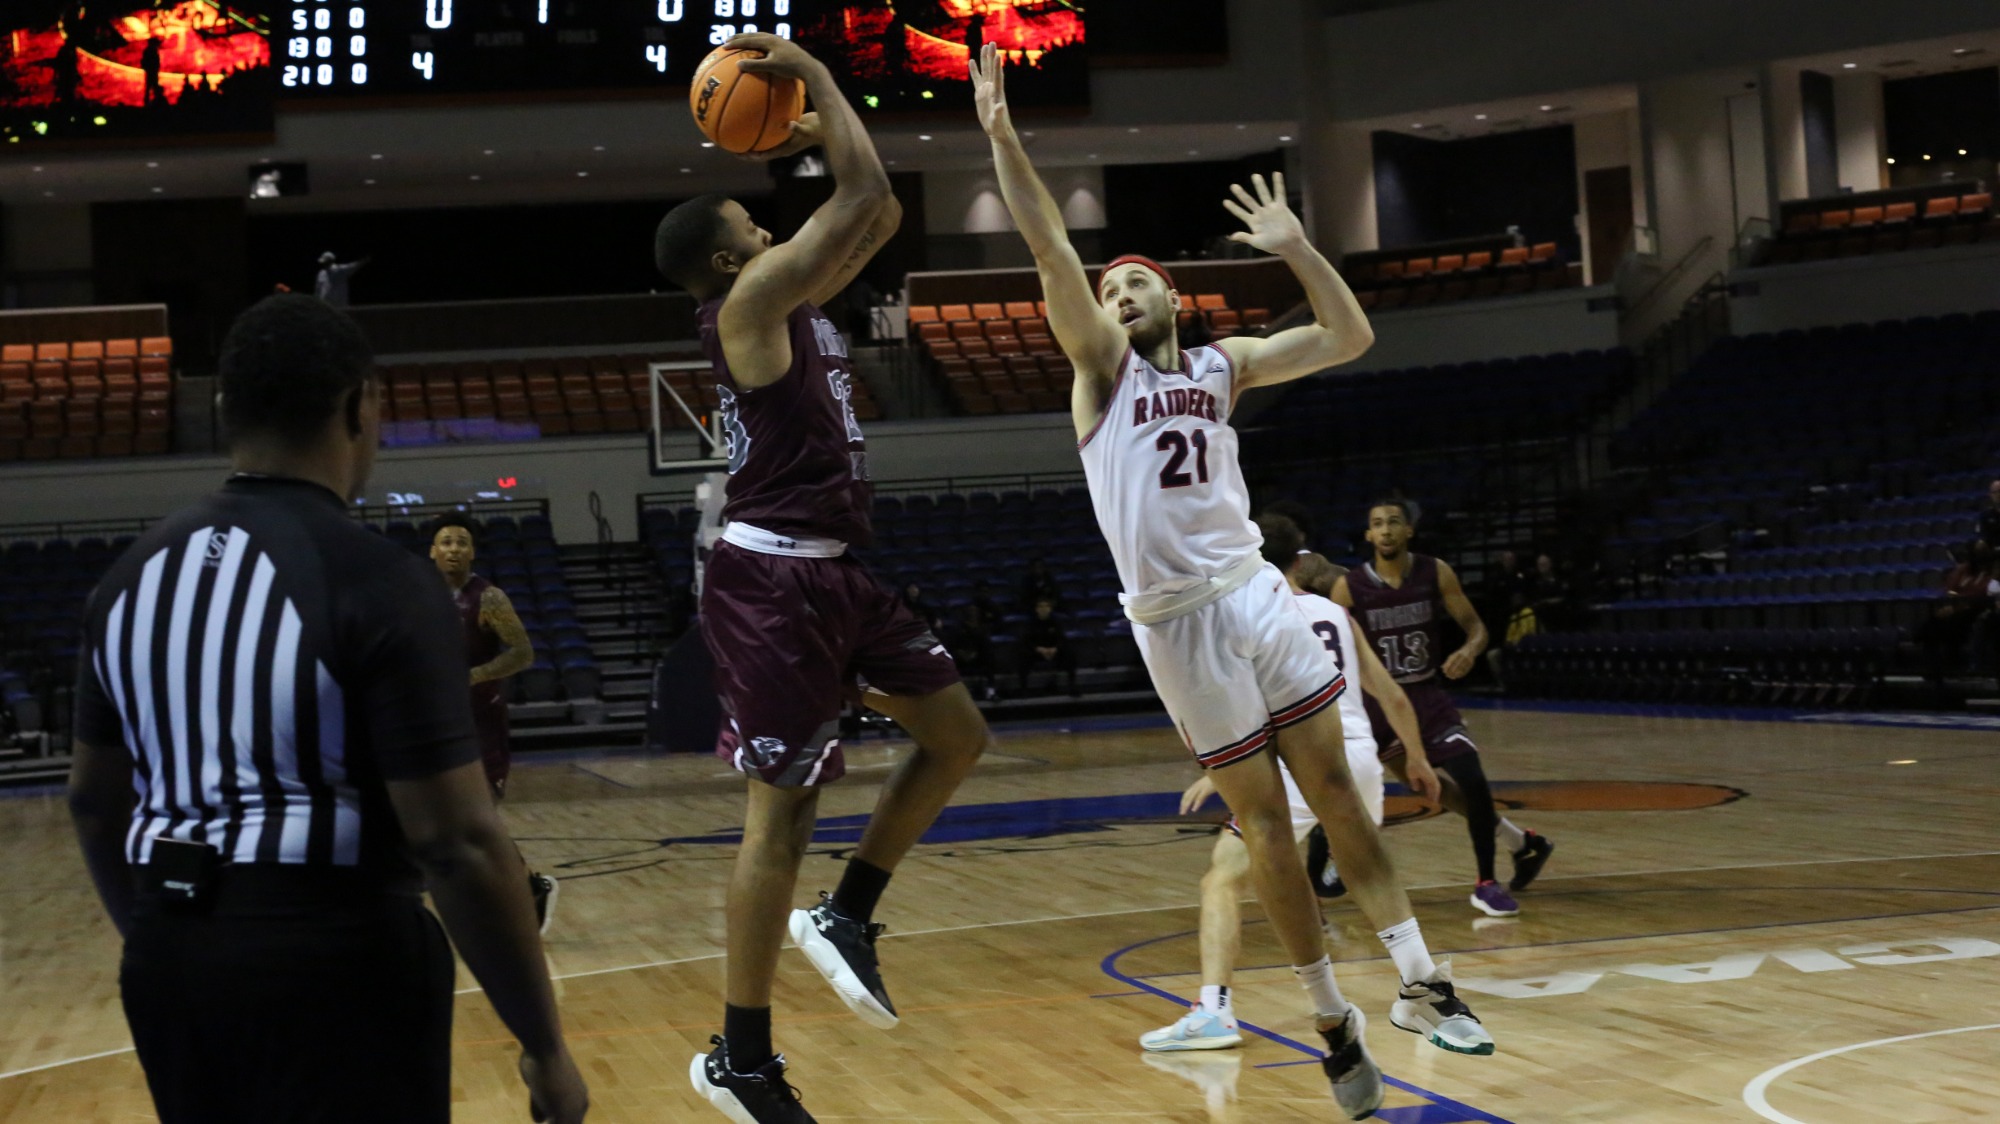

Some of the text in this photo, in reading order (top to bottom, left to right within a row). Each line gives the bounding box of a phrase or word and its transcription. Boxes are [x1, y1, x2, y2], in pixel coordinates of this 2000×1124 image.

[292, 7, 365, 30] 5 0 0
[288, 35, 366, 58] 13 0 0
[645, 44, 667, 73] 4
[282, 62, 368, 87] 21 0 0
[412, 51, 434, 80] 4
[1133, 387, 1218, 427] RAIDERS
[1155, 428, 1209, 489] 21
[1312, 620, 1345, 673] 3
[1377, 630, 1431, 677] 13
